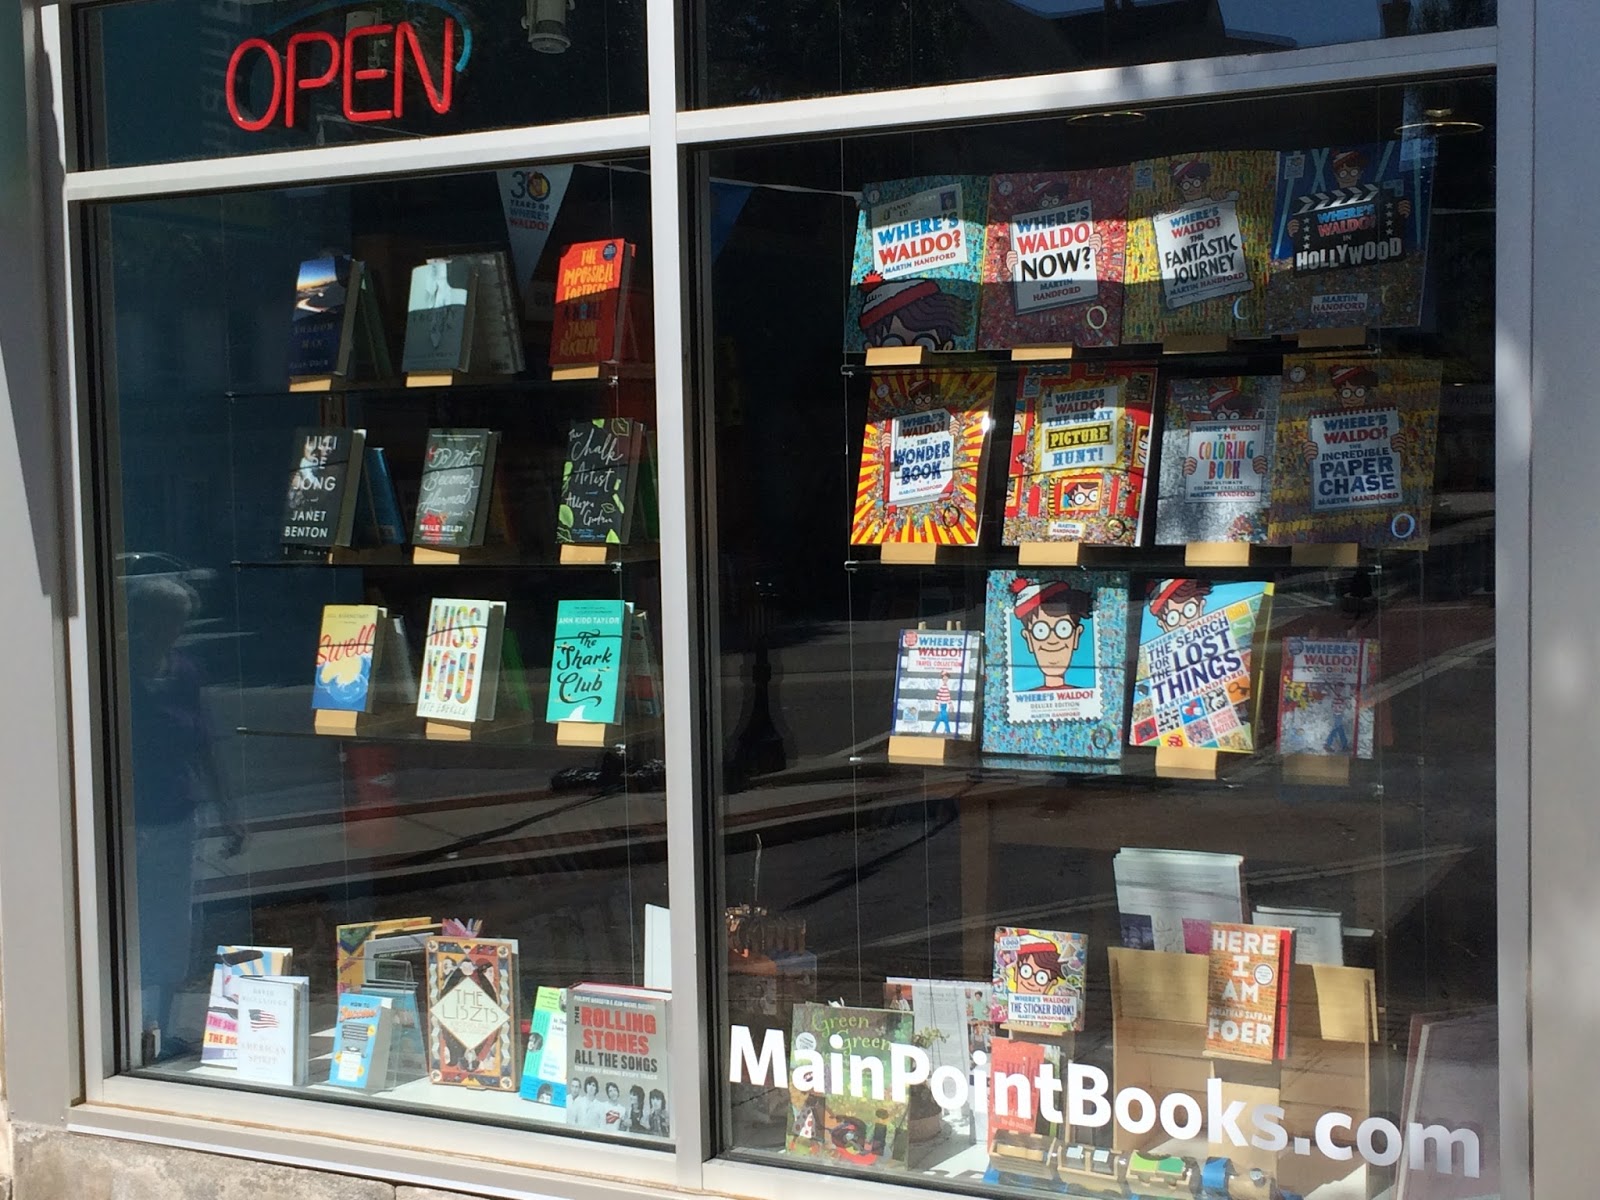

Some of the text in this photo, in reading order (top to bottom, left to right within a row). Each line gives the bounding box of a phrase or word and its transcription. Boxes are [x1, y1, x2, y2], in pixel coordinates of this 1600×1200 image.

[225, 17, 454, 131] OPEN
[1016, 206, 1090, 234] WHERE'S
[1170, 207, 1219, 228] WHERE'S
[1317, 204, 1375, 223] WHERE'S
[878, 212, 960, 246] WHERE'S
[1171, 217, 1221, 239] WALDO?
[1317, 216, 1376, 237] WALDO?
[879, 229, 961, 265] WALDO?
[1017, 223, 1090, 255] WALDO
[1189, 233, 1205, 242] THE
[581, 247, 598, 266] THE
[1165, 233, 1238, 269] FANTASTIC
[1296, 237, 1402, 271] HOLLYWOOD
[885, 252, 956, 274] MARTIN HANDFORD
[1021, 247, 1091, 282] NOW?
[1174, 253, 1235, 286] JOURNEY
[563, 263, 614, 287] IMPOSSIBLE
[1040, 278, 1073, 291] MARTIN
[1170, 272, 1244, 295] MARTIN HANDFORD
[1033, 286, 1081, 301] HANDFORD
[1322, 294, 1358, 302] MARTIN
[1313, 302, 1365, 311] HANDFORD
[1055, 388, 1105, 404] WHERE'S
[1055, 399, 1105, 415] WALDO?
[902, 412, 945, 428] WHERE'S
[1047, 410, 1113, 427] THE GREAT
[1323, 414, 1388, 432] WHERE'S
[568, 428, 584, 441] The
[902, 421, 945, 438] WALDO?
[1050, 426, 1108, 448] PICTURE
[1323, 427, 1389, 445] WALDO?
[571, 428, 624, 466] Chalk
[916, 437, 928, 446] THE
[1198, 440, 1255, 461] COLORING
[894, 440, 950, 466] WONDER
[1052, 447, 1104, 467] HUNT!
[1322, 447, 1390, 461] INCREDIBLE
[574, 461, 615, 492] Artist
[901, 461, 941, 486] BOOK
[1208, 460, 1241, 480] BOOK
[1320, 456, 1394, 478] PAPER
[293, 476, 336, 491] JONG
[1216, 490, 1256, 498] HANDFORD
[1318, 474, 1396, 496] CHASE
[1318, 492, 1399, 505] MARTIN HANDFORD
[291, 510, 327, 522] JANET
[284, 526, 328, 538] BENTON
[428, 605, 482, 649] MISS
[558, 617, 620, 625] ANN KIDD TAYLOR
[1147, 609, 1226, 650] WHERE'S WALDO?
[316, 623, 377, 666] Swell
[577, 629, 600, 649] The
[919, 636, 963, 647] WHERE'S
[1148, 616, 1229, 661] THE SEARCH
[1305, 644, 1358, 654] WHERE'S
[556, 646, 612, 671] Shark
[918, 647, 962, 658] WALDO?
[1173, 628, 1230, 673] LOST
[1303, 655, 1357, 666] WALDO?
[933, 660, 963, 668] COLLECTION
[1149, 655, 1170, 672] FOR
[424, 649, 477, 704] YOU
[1151, 669, 1172, 684] THE
[1153, 649, 1241, 704] THINGS
[557, 672, 602, 706] Club
[1016, 690, 1094, 703] WHERE'S WALDO?
[1155, 669, 1244, 713] MARTIN HANDFORD
[1212, 929, 1277, 956] HERE
[1232, 955, 1250, 977] I
[455, 989, 483, 1007] THE
[1014, 995, 1041, 1003] WHERE'S
[1221, 979, 1259, 1003] AM
[442, 1003, 499, 1022] LISZTS
[1010, 1002, 1075, 1016] THE STICKER BOOK!
[1245, 1010, 1273, 1021] SAFRAN
[208, 1015, 223, 1028] THE
[581, 1006, 656, 1035] ROLLING
[812, 1010, 869, 1037] Green
[208, 1032, 223, 1043] THE
[583, 1028, 649, 1056] STONES
[836, 1030, 892, 1055] Green
[1208, 1018, 1273, 1046] FOER
[574, 1049, 658, 1073] ALL THE SONGS
[728, 1023, 1480, 1179] MainPointBooks.com
